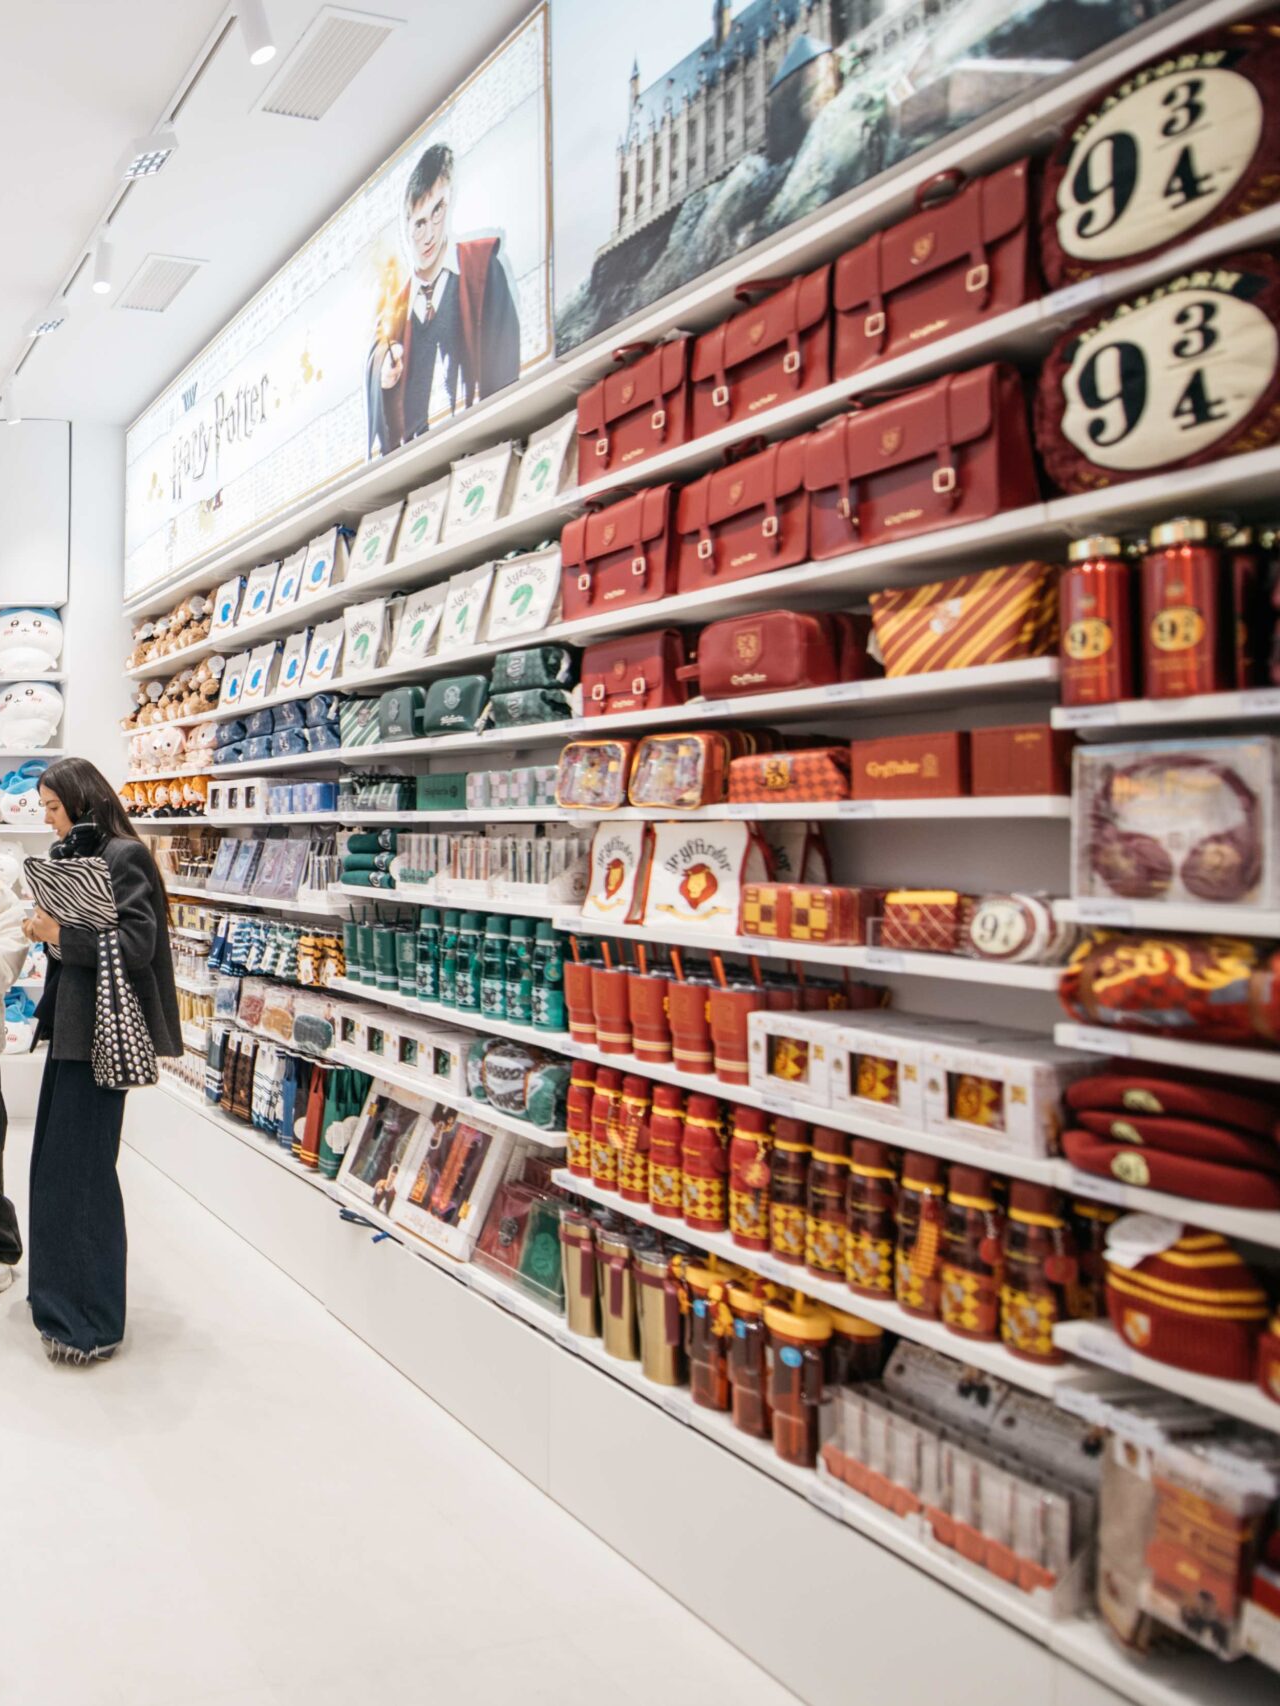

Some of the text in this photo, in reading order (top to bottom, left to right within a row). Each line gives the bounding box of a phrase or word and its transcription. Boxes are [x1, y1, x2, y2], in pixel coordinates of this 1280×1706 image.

[1073, 131, 1139, 239] 9
[168, 373, 269, 504] Harry Potter
[1078, 341, 1148, 447] 9
